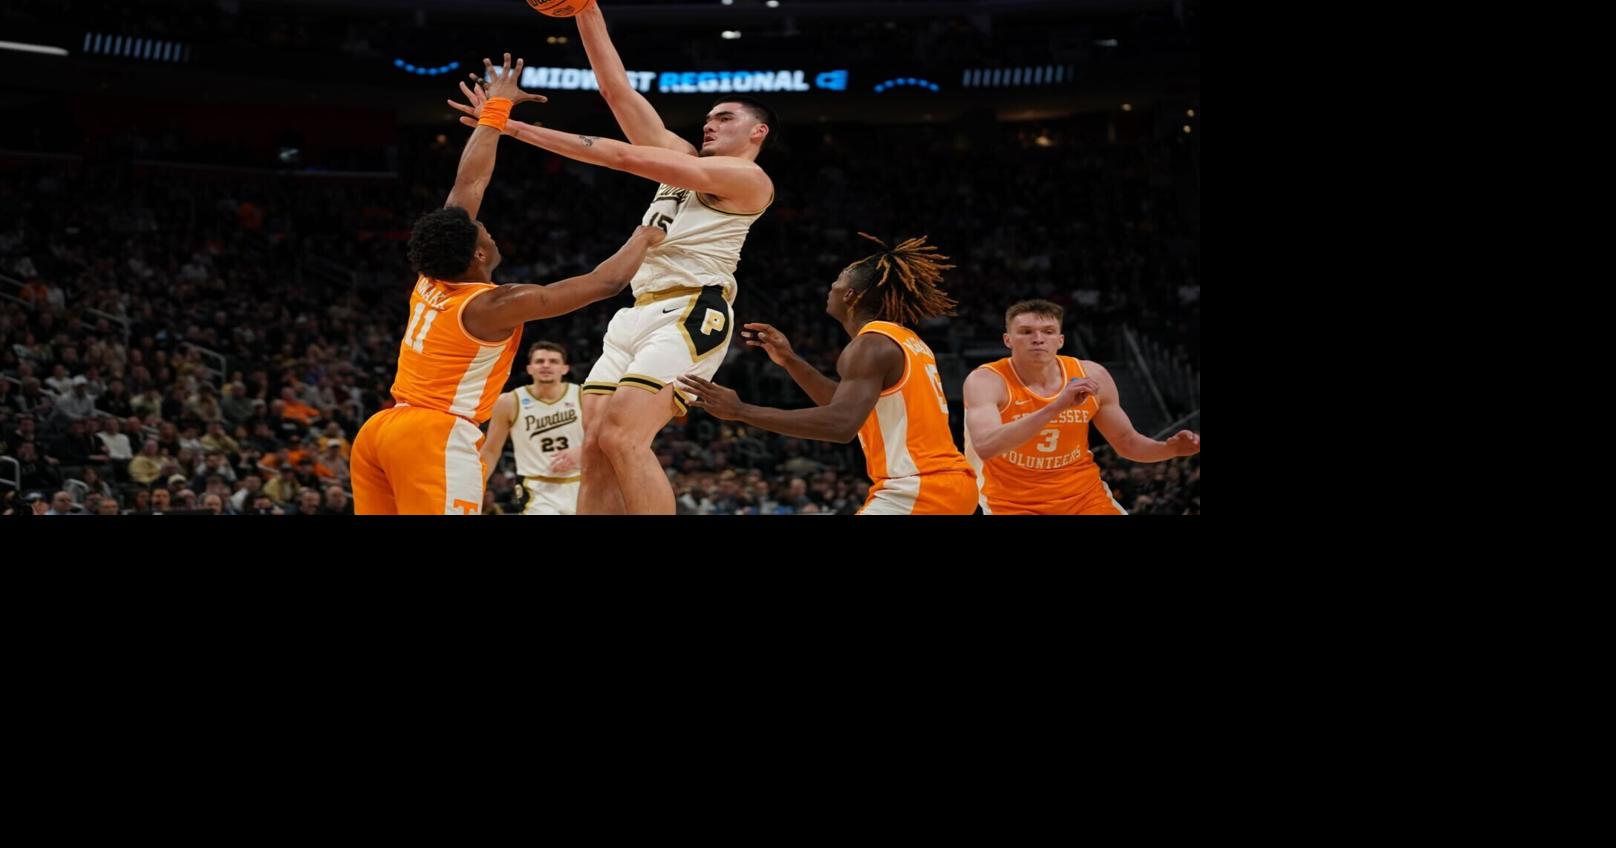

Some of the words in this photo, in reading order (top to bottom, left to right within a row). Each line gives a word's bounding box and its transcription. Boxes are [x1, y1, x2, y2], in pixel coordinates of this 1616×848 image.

[521, 66, 657, 92] MIDWST
[659, 70, 810, 93] REGIONAL
[405, 302, 438, 354] 11
[700, 307, 726, 336] P
[525, 409, 577, 435] Purdue
[541, 437, 570, 453] 23
[1036, 428, 1060, 453] 3
[1002, 445, 1081, 469] OLUNTEERS
